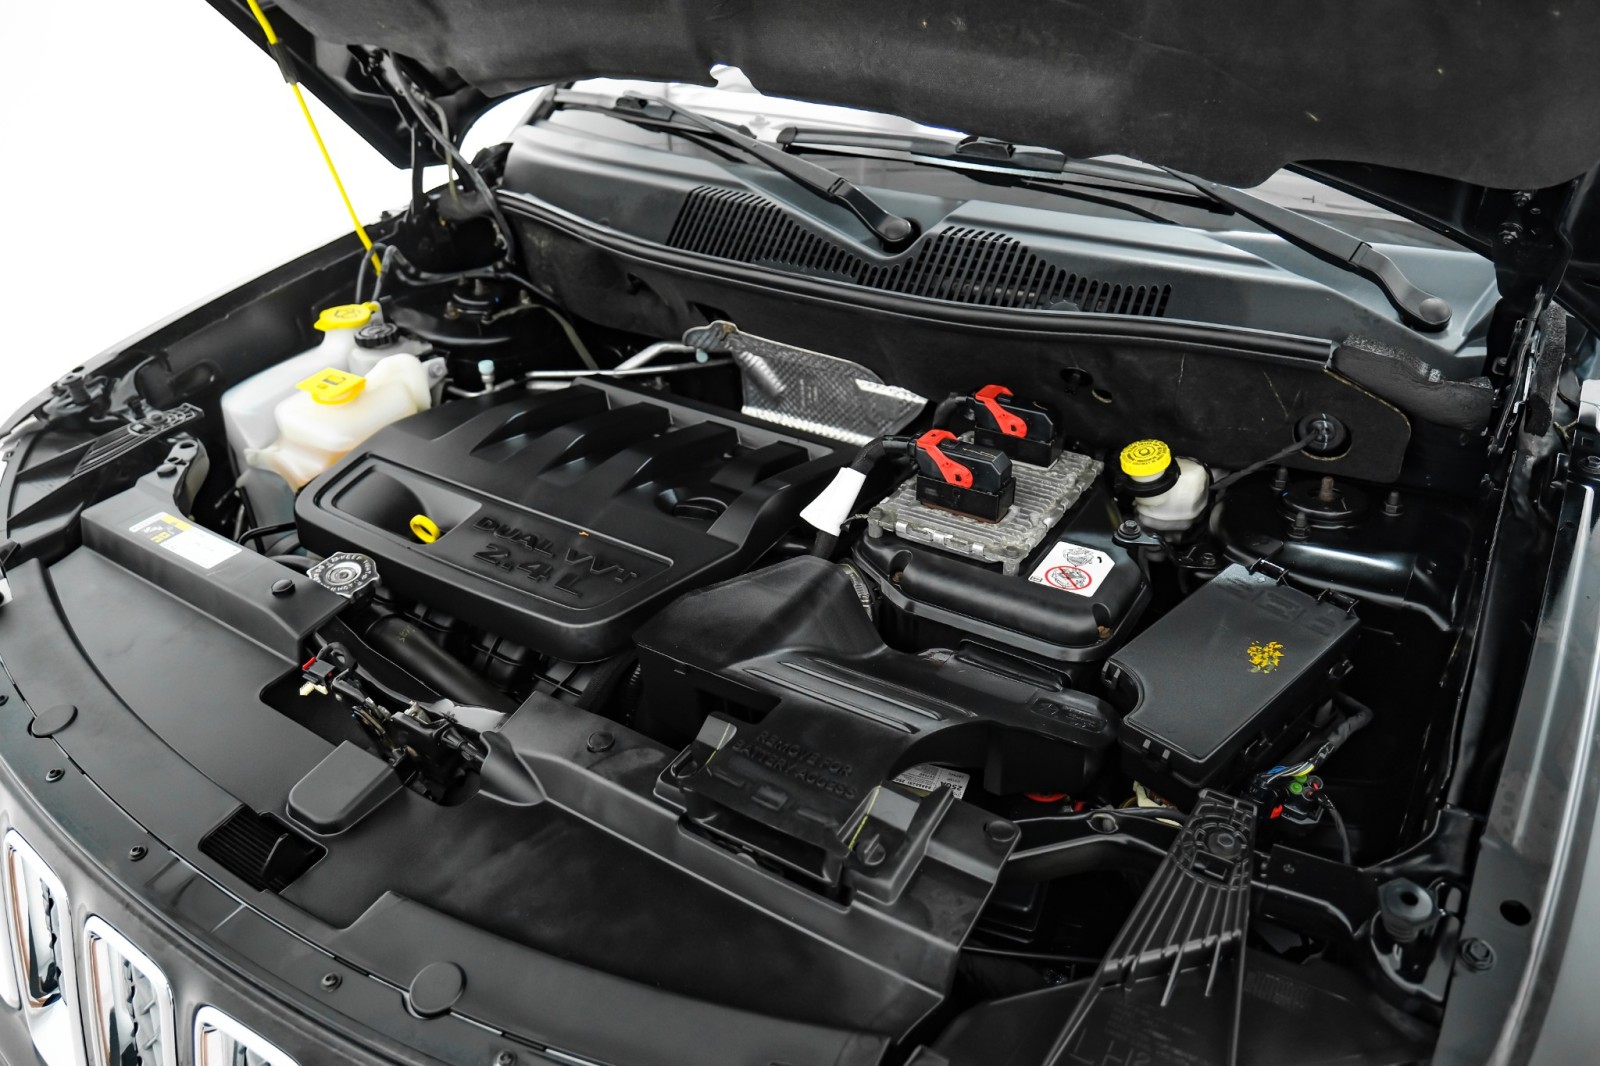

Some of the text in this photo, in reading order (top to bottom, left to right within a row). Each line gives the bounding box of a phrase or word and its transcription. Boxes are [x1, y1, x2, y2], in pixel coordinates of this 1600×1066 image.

[473, 515, 638, 584] DUAL VVT
[732, 739, 857, 799] BATTERY ACCESS
[757, 731, 853, 777] REMOVE FOR
